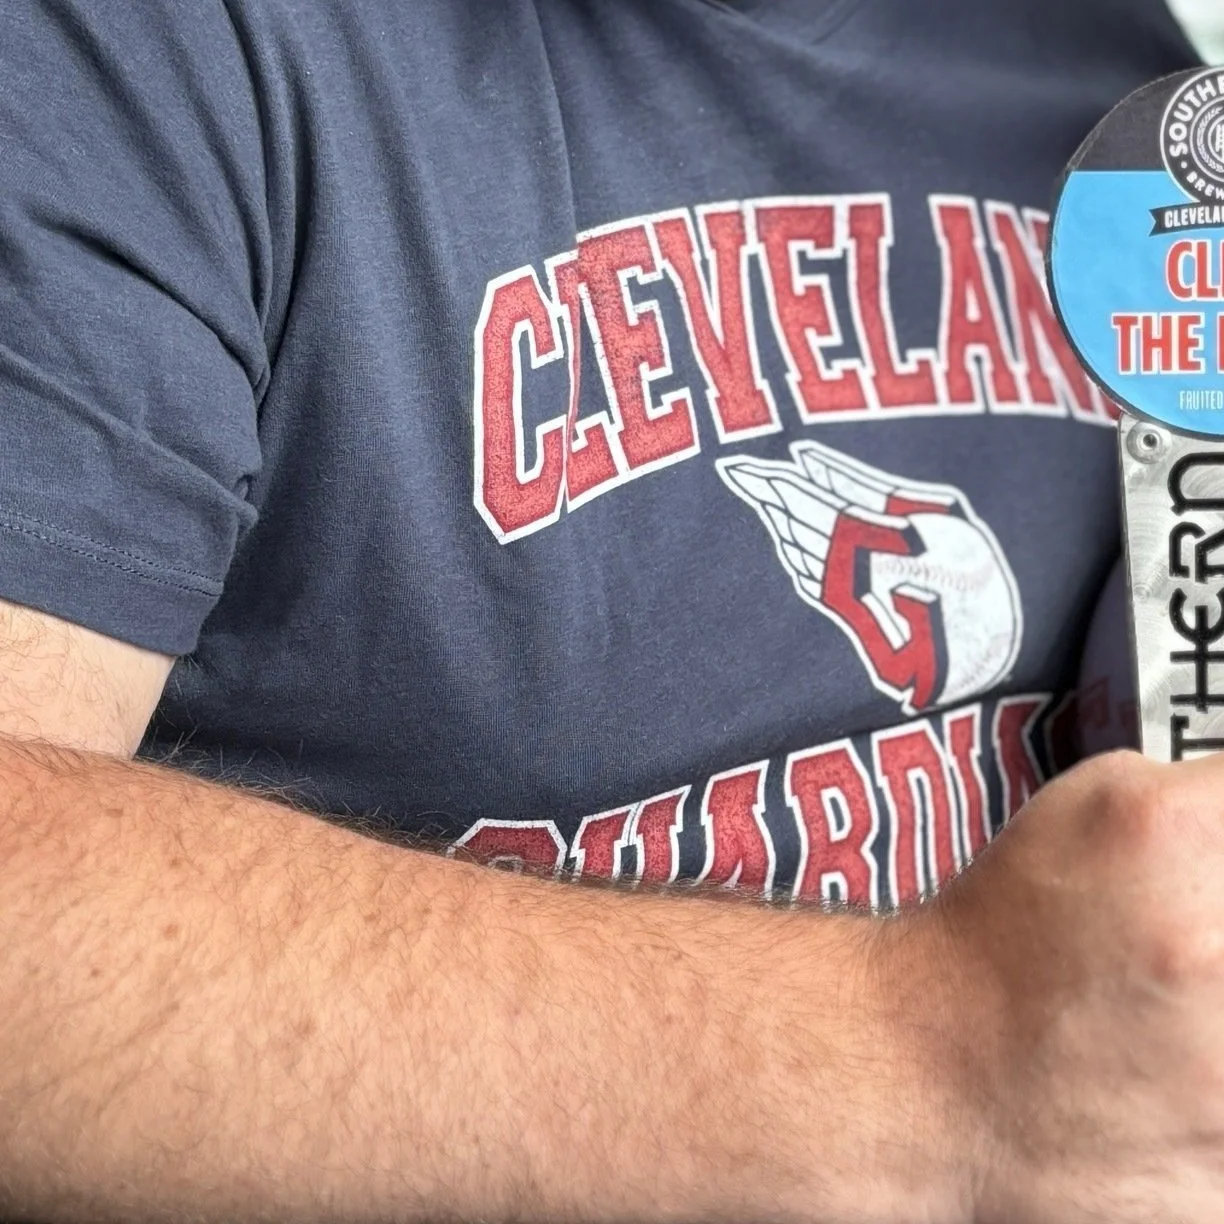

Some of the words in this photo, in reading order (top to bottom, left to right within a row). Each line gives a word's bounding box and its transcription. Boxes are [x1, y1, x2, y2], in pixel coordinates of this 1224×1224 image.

[473, 192, 1120, 545] CLEVELAN
[1112, 311, 1206, 375] THE
[1179, 390, 1224, 411] FRUITED
